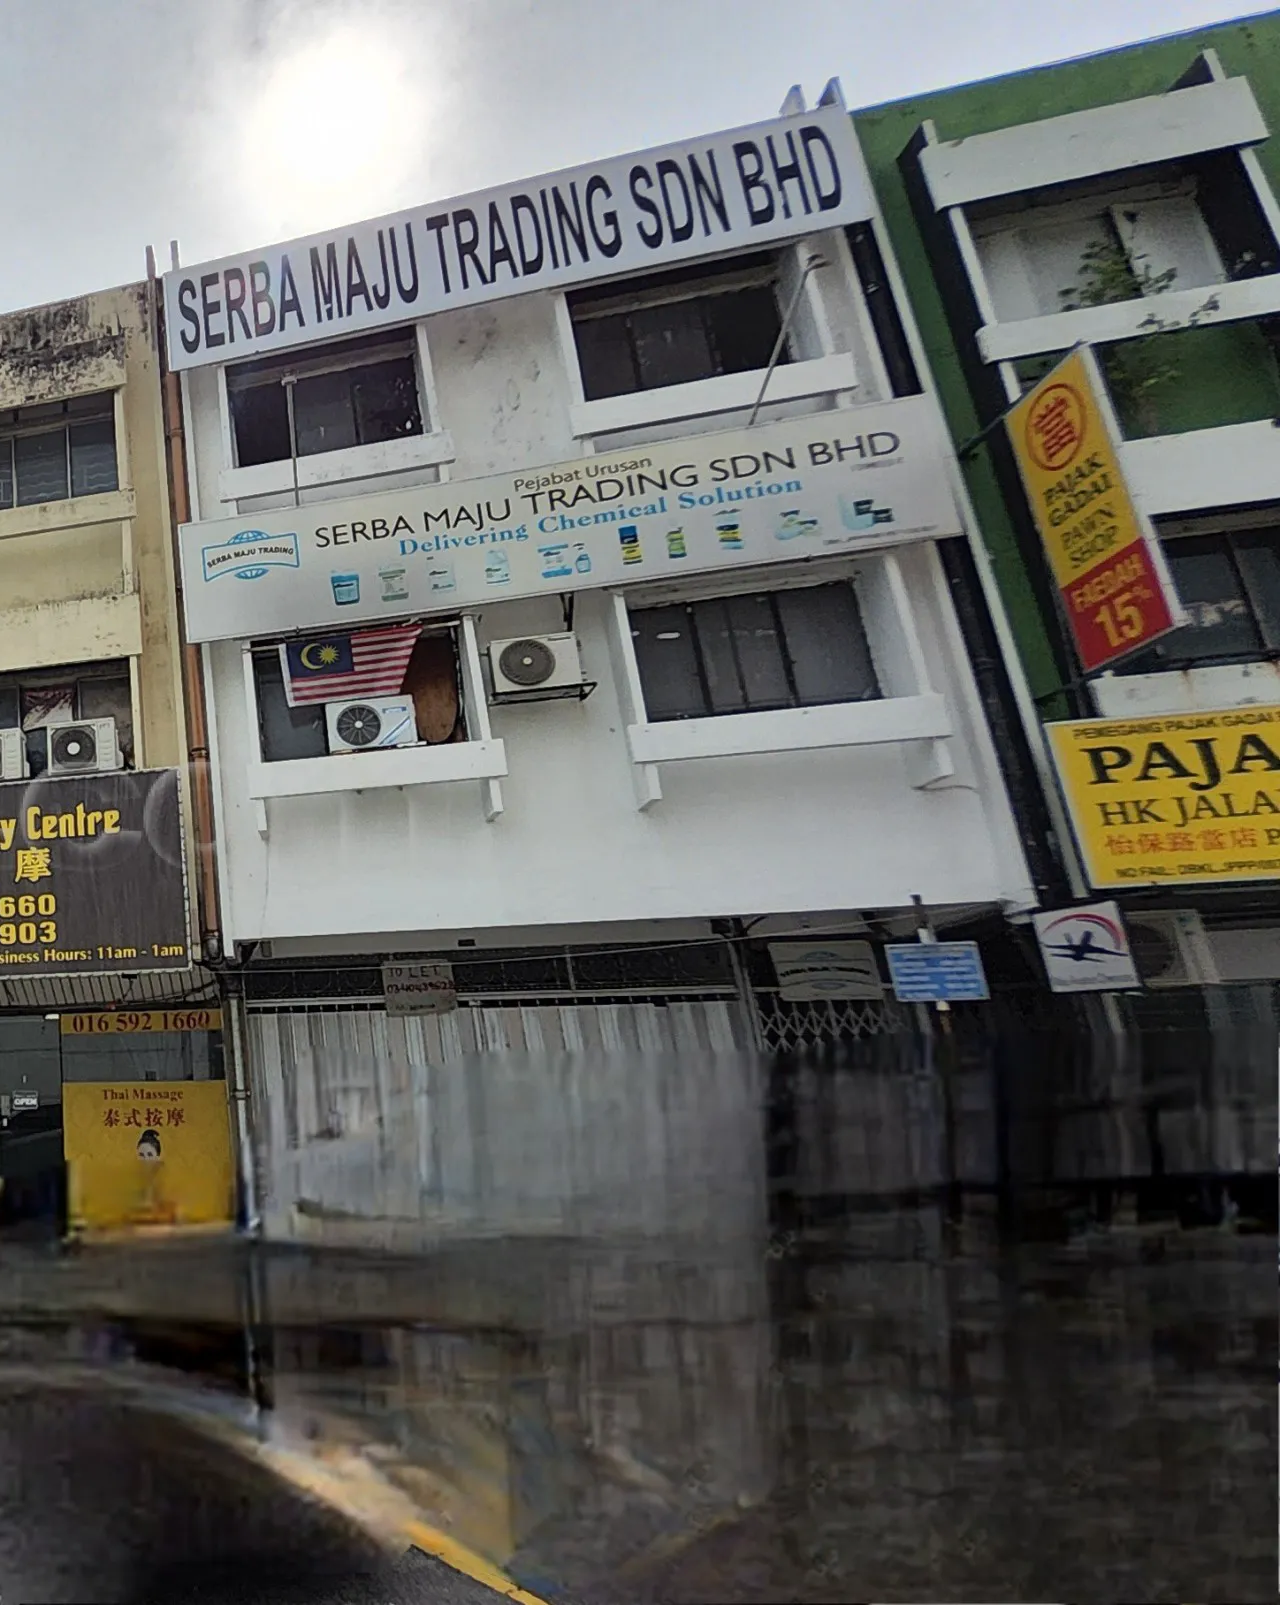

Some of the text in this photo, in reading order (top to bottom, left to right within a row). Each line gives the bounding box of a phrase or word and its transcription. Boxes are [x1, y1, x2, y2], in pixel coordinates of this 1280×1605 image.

[178, 124, 842, 353] SERBA MAJU TRADING SDN BHD
[514, 456, 653, 492] Pejabat Urusan
[315, 515, 415, 549] SERBA
[423, 498, 511, 532] MAJU
[520, 464, 698, 515] TRADING
[709, 447, 797, 481] SDN
[808, 432, 901, 466] BHD
[399, 478, 802, 556] Delivering Chemical Solution
[206, 546, 294, 568] SERBA MAJU TRADING
[26, 803, 120, 841] Centre
[1096, 790, 1280, 828] HK JALA
[44, 947, 93, 962] Hours:
[97, 945, 136, 960] 11am
[151, 943, 183, 957] 1am
[408, 965, 441, 978] LET
[73, 1011, 210, 1032] 016 592 1660
[102, 1088, 184, 1102] Thai Massage
[104, 1107, 185, 1127] 泰式按摩
